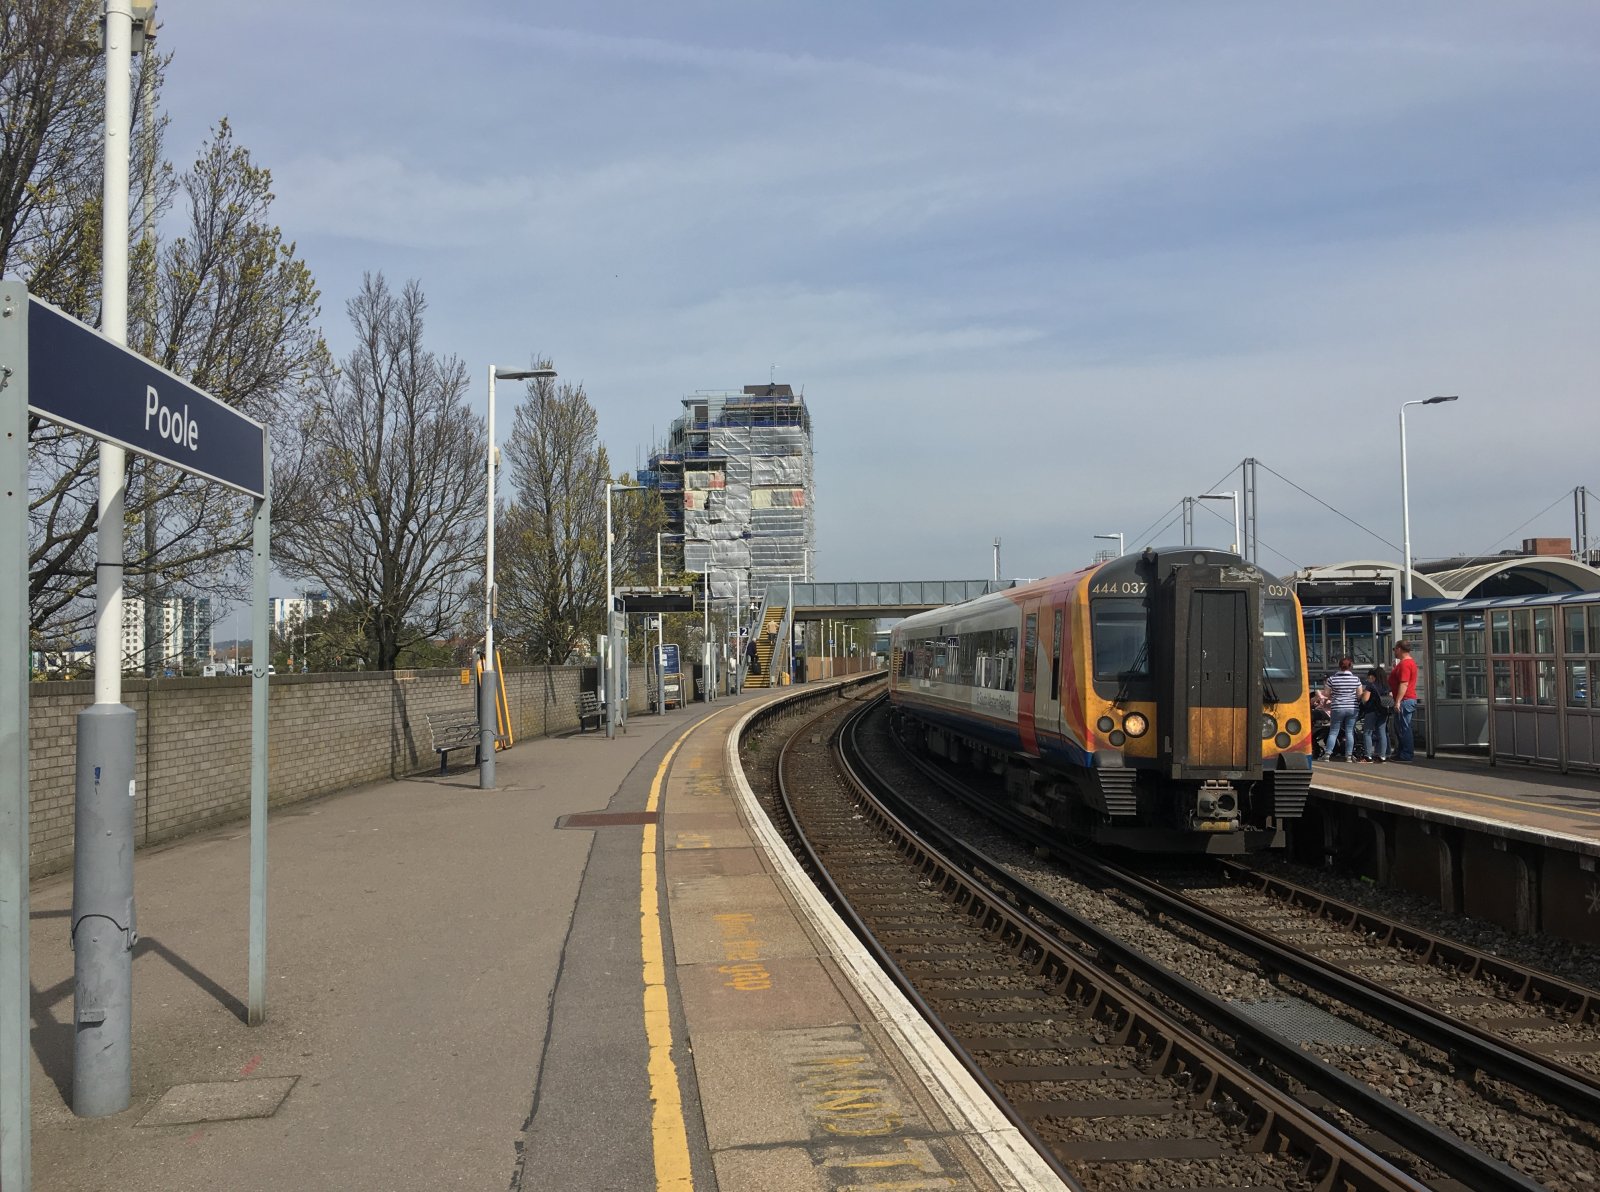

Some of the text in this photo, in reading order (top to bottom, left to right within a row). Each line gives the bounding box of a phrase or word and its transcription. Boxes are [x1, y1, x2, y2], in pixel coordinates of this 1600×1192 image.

[145, 384, 199, 451] Poole
[1092, 582, 1149, 594] 444 037
[1268, 584, 1288, 597] 037
[741, 627, 748, 636] 2
